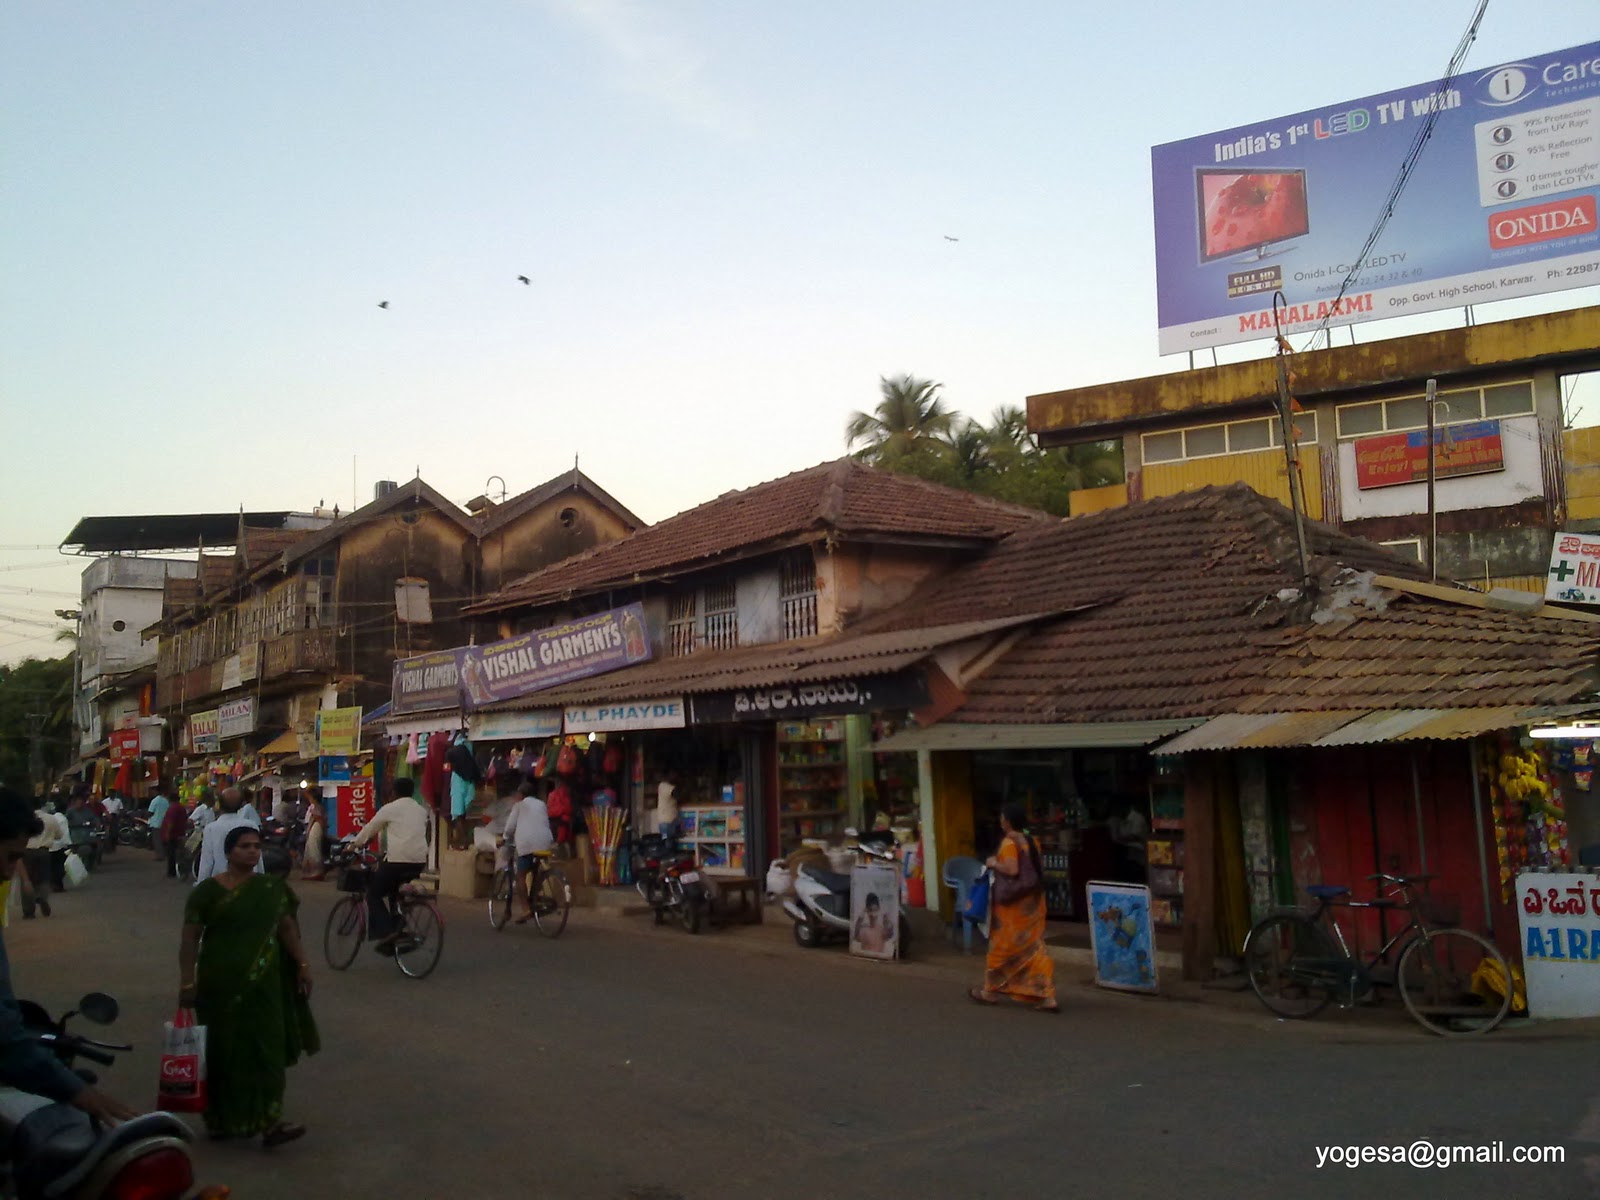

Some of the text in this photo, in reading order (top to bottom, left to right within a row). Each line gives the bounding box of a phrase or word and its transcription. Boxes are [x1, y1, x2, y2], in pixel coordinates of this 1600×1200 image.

[1543, 58, 1600, 85] Care
[1545, 80, 1600, 97] Technolo
[1215, 88, 1461, 162] India's 1st LED TV with
[1527, 119, 1589, 137] from UV Rays
[1544, 108, 1592, 123] Protection
[1527, 136, 1592, 155] 95% Reflection
[1550, 151, 1570, 160] Free
[1526, 162, 1599, 182] 10 times tougher
[1532, 181, 1551, 192] than
[1553, 176, 1575, 188] LCD
[1495, 207, 1590, 240] ONIDA
[1233, 270, 1276, 286] FULL HD
[1294, 269, 1325, 282] Onida
[1365, 256, 1388, 269] LED
[1390, 252, 1407, 264] TV
[1389, 296, 1411, 307] Opp.
[1412, 292, 1437, 303] Govt.
[1438, 288, 1460, 298] High
[1500, 275, 1537, 287] Karwar.
[1566, 262, 1600, 275] 22987
[1190, 327, 1218, 338] Contact
[1239, 293, 1373, 333] MAHALAXMI
[1575, 561, 1600, 588] M
[482, 647, 537, 681] VISHAL
[540, 623, 622, 666] GARMENTS
[348, 782, 367, 827] airtel
